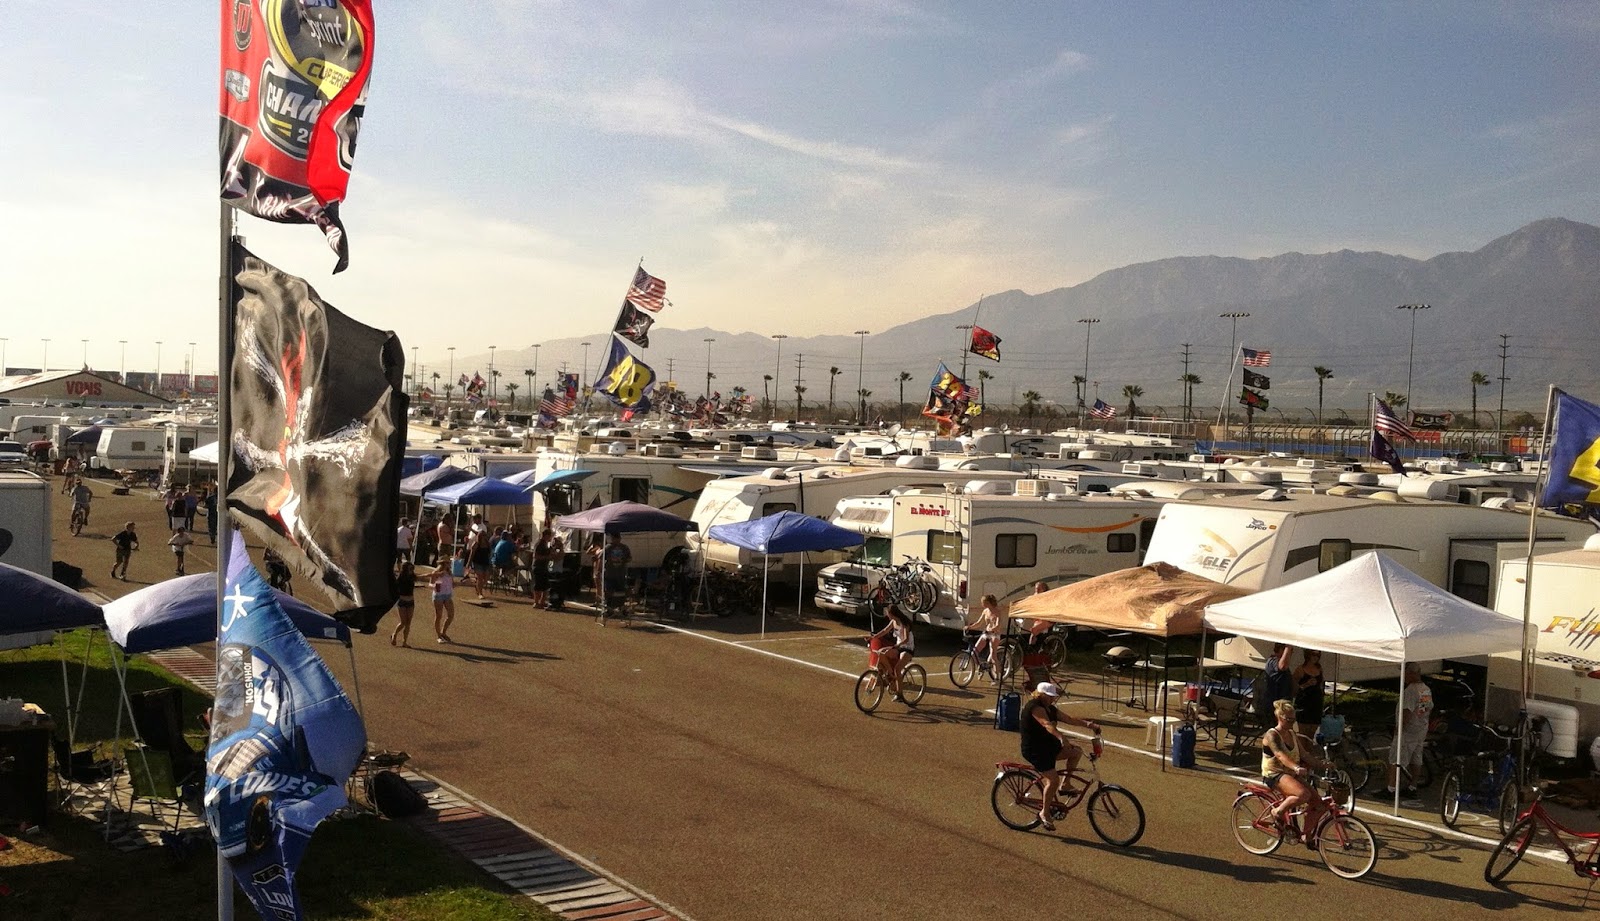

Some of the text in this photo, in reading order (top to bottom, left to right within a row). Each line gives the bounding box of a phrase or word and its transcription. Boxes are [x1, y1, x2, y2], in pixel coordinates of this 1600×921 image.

[66, 381, 102, 396] VONS
[607, 355, 652, 406] 48
[243, 662, 255, 704] JOHNSON
[229, 771, 318, 804] LOWE'S
